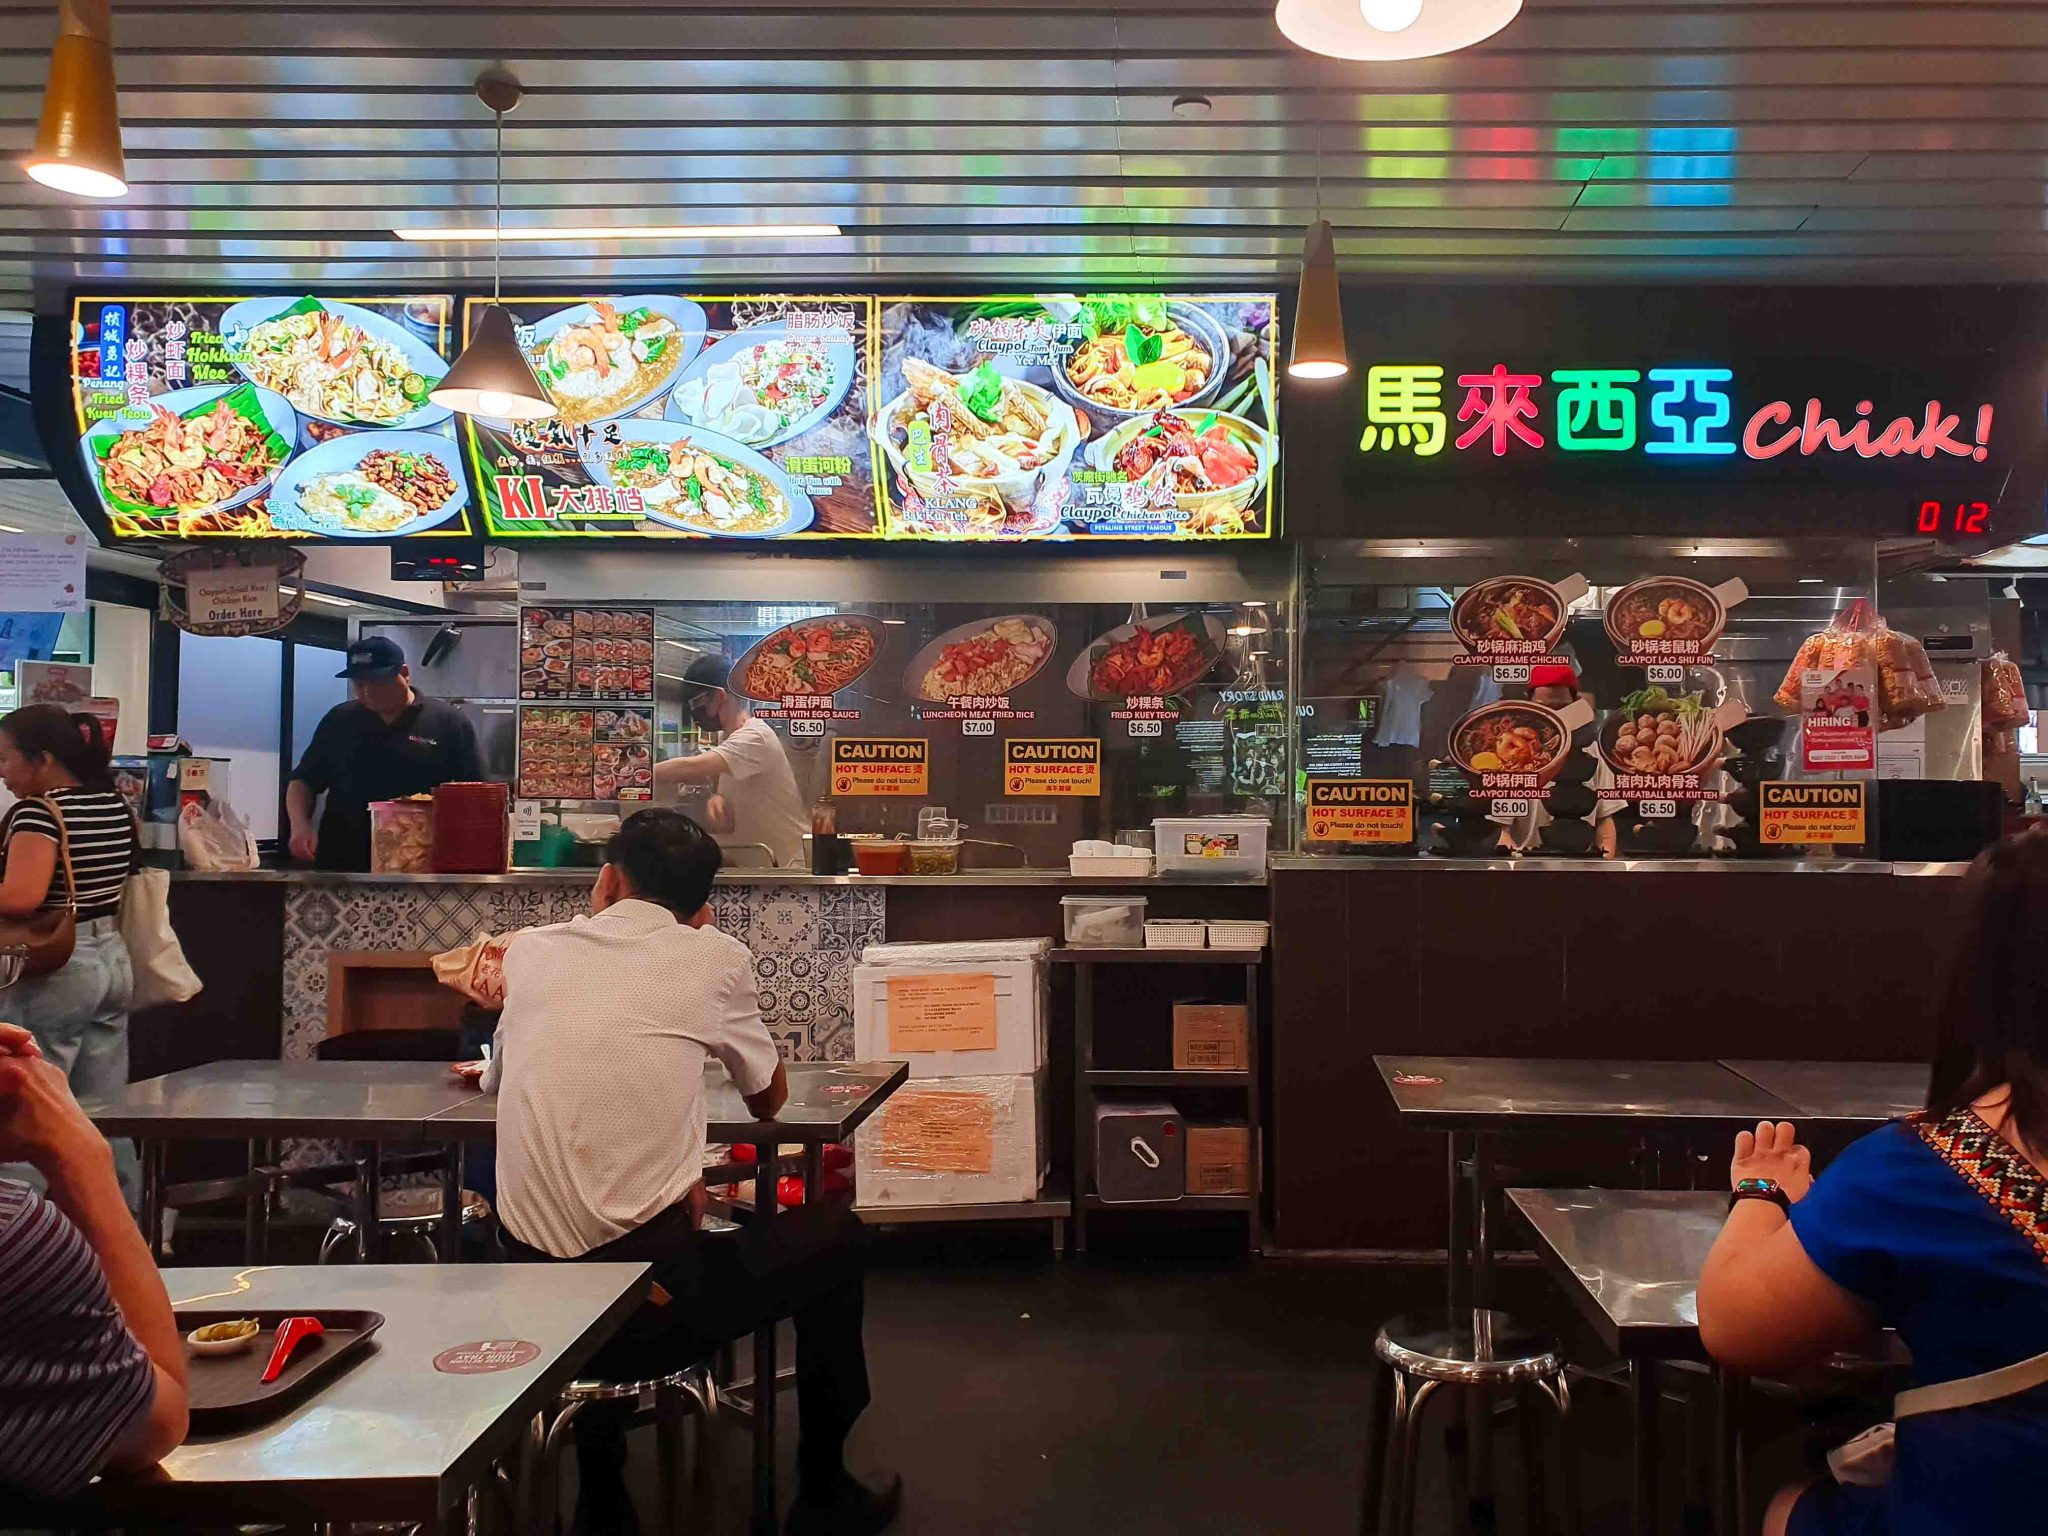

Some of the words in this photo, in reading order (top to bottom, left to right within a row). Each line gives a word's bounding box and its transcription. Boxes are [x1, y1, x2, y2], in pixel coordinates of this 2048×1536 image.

[786, 311, 856, 330] 腊肠炒饭
[165, 320, 187, 381] 炒虾面
[186, 347, 254, 363] Hokkien
[1029, 344, 1048, 353] Tom
[1051, 344, 1073, 354] Yum
[1015, 355, 1034, 366] Yee
[1036, 355, 1060, 366] Mee
[125, 338, 150, 406] 炒粿条
[192, 364, 228, 380] Mee
[82, 377, 125, 390] Penang
[85, 407, 118, 422] Kuey
[1358, 363, 1737, 459] 馬來西亞
[1742, 396, 1995, 463] Chiak!
[911, 428, 928, 466] 巴生
[929, 401, 959, 494] 肉骨茶
[785, 456, 852, 474] 滑蛋河粉
[494, 476, 557, 521] KL
[551, 485, 647, 513] 大排档
[1084, 482, 1178, 508] 瓦煲鸡饭
[924, 497, 978, 509] KLANG
[903, 510, 925, 521] Bak
[926, 510, 948, 521] Kut
[949, 510, 968, 521] Teh
[1120, 510, 1162, 520] Chicken
[1165, 511, 1188, 520] Rice
[208, 608, 236, 620] Order
[240, 607, 263, 618] Here
[1477, 639, 1547, 654] 砂锅麻油鸡
[1631, 639, 1700, 654] 砂锅老鼠粉
[1453, 655, 1493, 664] CLAYPOT
[1494, 655, 1528, 664] SESAME
[1529, 656, 1569, 664] CHICKEN
[1617, 655, 1657, 664] CLAYPOT
[1658, 655, 1677, 664] LAO
[1678, 656, 1695, 664] SHU
[1696, 656, 1713, 664] FUN
[1495, 667, 1528, 680] $6.50
[1649, 668, 1682, 679] $6.00
[781, 694, 833, 709] 滑蛋伊面
[946, 695, 1010, 709] 午餐肉炒饭
[1125, 695, 1164, 710] 炒粿条
[771, 710, 788, 718] MEE
[789, 710, 810, 718] WITH
[812, 710, 831, 718] EGG
[832, 711, 860, 719] SAUCE
[922, 711, 967, 719] LUNCHEON
[969, 711, 990, 719] MEAT
[992, 711, 1014, 719] FRIED
[1016, 711, 1035, 719] RICE
[1111, 711, 1133, 719] FRIED
[1134, 711, 1155, 719] KUEY
[1156, 711, 1180, 719] TEOW
[792, 722, 823, 733] $6.50
[965, 722, 993, 733] $7.00
[1130, 723, 1160, 733] $6.50
[1807, 717, 1852, 728] HIRING
[839, 744, 922, 759] CAUTION
[1012, 745, 1094, 759] CAUTION
[835, 764, 859, 774] HOT
[861, 764, 912, 774] SURFACE
[1008, 765, 1032, 774] HOT
[1033, 765, 1083, 774] SURFACE
[852, 776, 875, 784] Please
[876, 776, 885, 784] do
[886, 776, 898, 784] not
[898, 776, 921, 784] touch!
[1481, 773, 1538, 788] 砂锅伊面
[1616, 774, 1700, 789] 猪肉丸肉骨茶
[1315, 786, 1406, 801] CAUTION
[1468, 789, 1509, 798] CLAYPOT
[1510, 789, 1551, 798] NOODLES
[1597, 790, 1620, 799] PORK
[1622, 790, 1666, 799] MEATBALL
[1666, 790, 1685, 799] BAK
[1686, 791, 1702, 799] KUT
[1702, 791, 1718, 799] TEH
[1767, 788, 1858, 803] CAUTION
[1312, 808, 1337, 817] HOT
[1339, 808, 1394, 818] SURFACE
[1493, 801, 1527, 814] $6.00
[1641, 803, 1674, 814] $6.50
[1763, 810, 1790, 819] HOT
[1791, 810, 1847, 820] SURFACE
[1329, 821, 1354, 829] Please
[1355, 821, 1365, 829] do
[1366, 821, 1379, 829] not
[1782, 823, 1807, 831] Please
[1808, 823, 1818, 831] do
[1819, 823, 1832, 831] not
[1832, 823, 1856, 831] touch!
